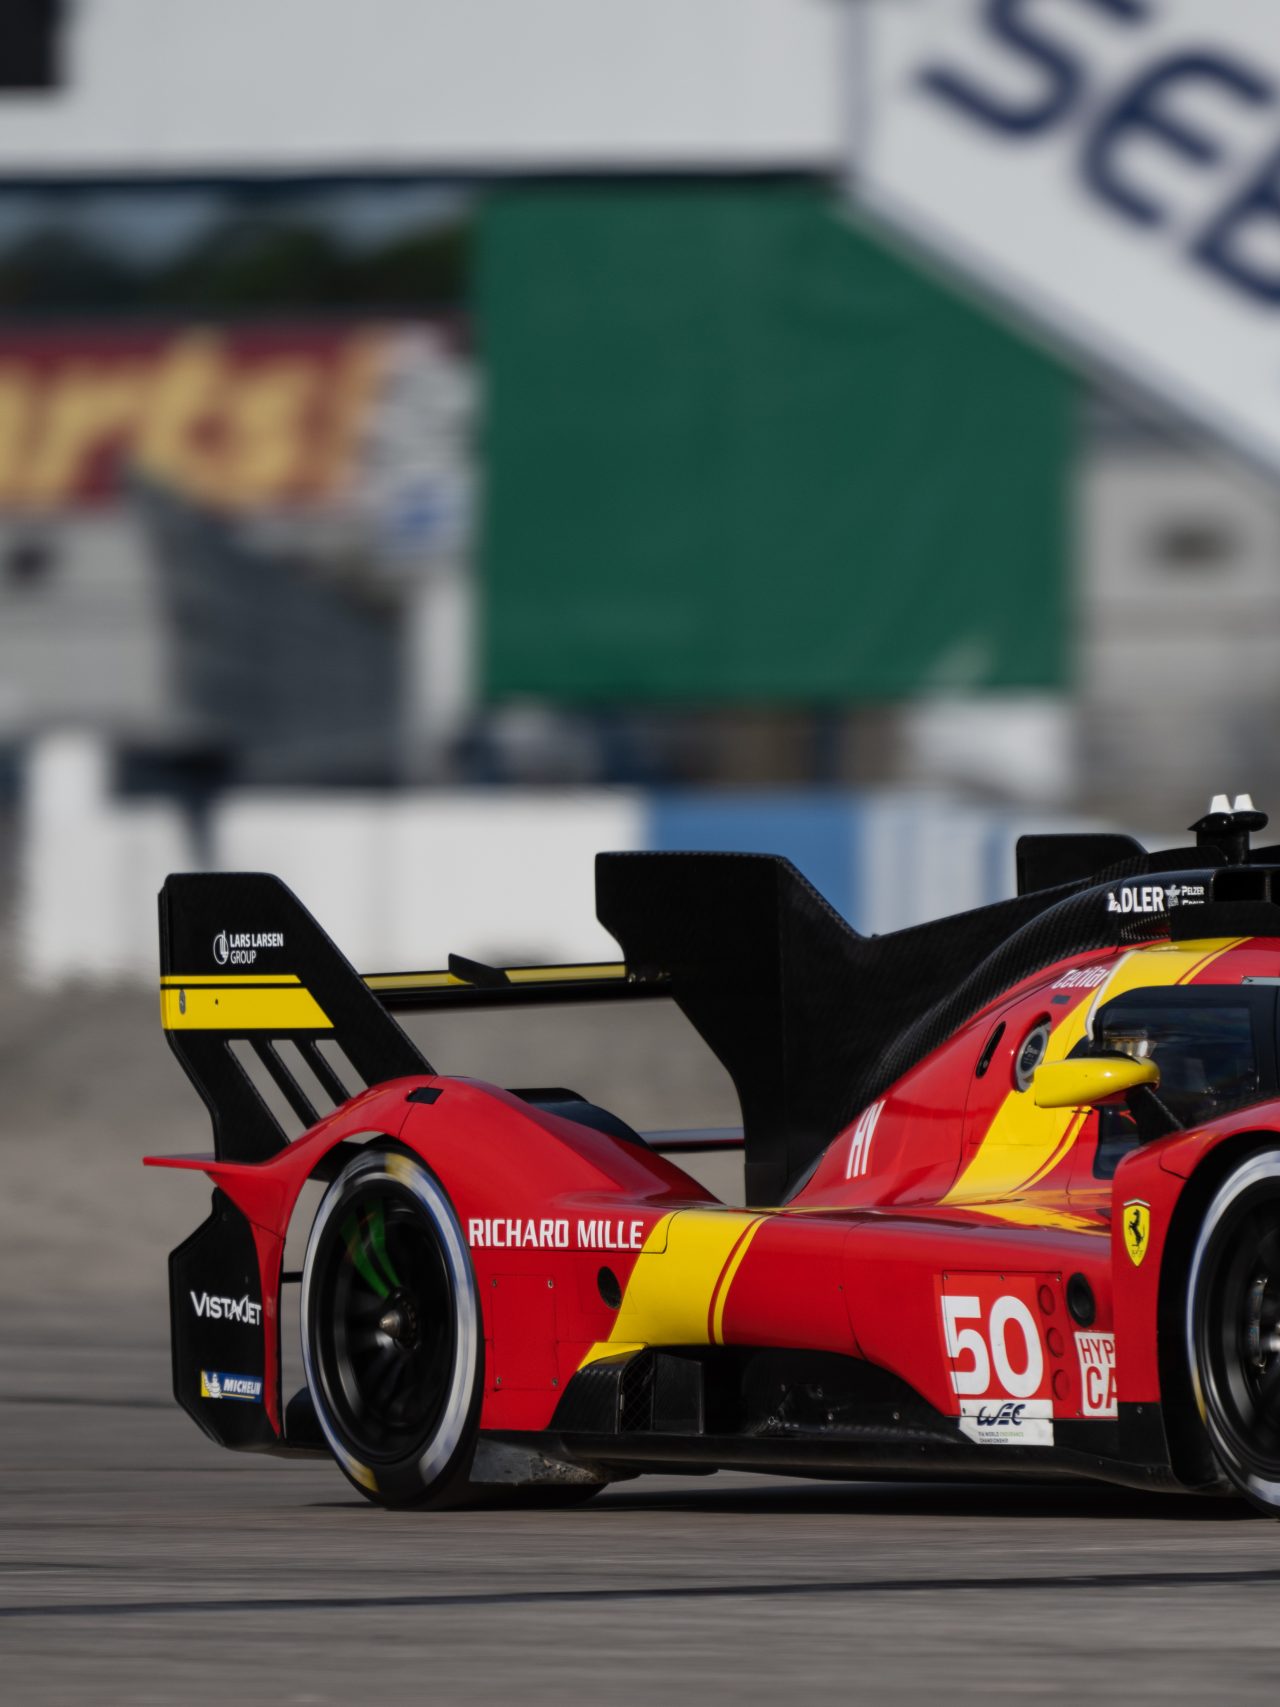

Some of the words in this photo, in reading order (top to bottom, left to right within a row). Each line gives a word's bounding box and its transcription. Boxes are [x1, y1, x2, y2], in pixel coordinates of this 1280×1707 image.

[1107, 886, 1164, 912] ADLER
[1181, 886, 1205, 896] PELZER
[229, 934, 250, 948] LARS
[251, 932, 284, 947] LARSEN
[230, 949, 256, 964] GROUP
[468, 1218, 569, 1248] RICHARD
[577, 1219, 645, 1249] MILLE
[941, 1295, 1044, 1399] 50
[223, 1378, 262, 1396] MICHELIN
[976, 1402, 1026, 1427] WEC
